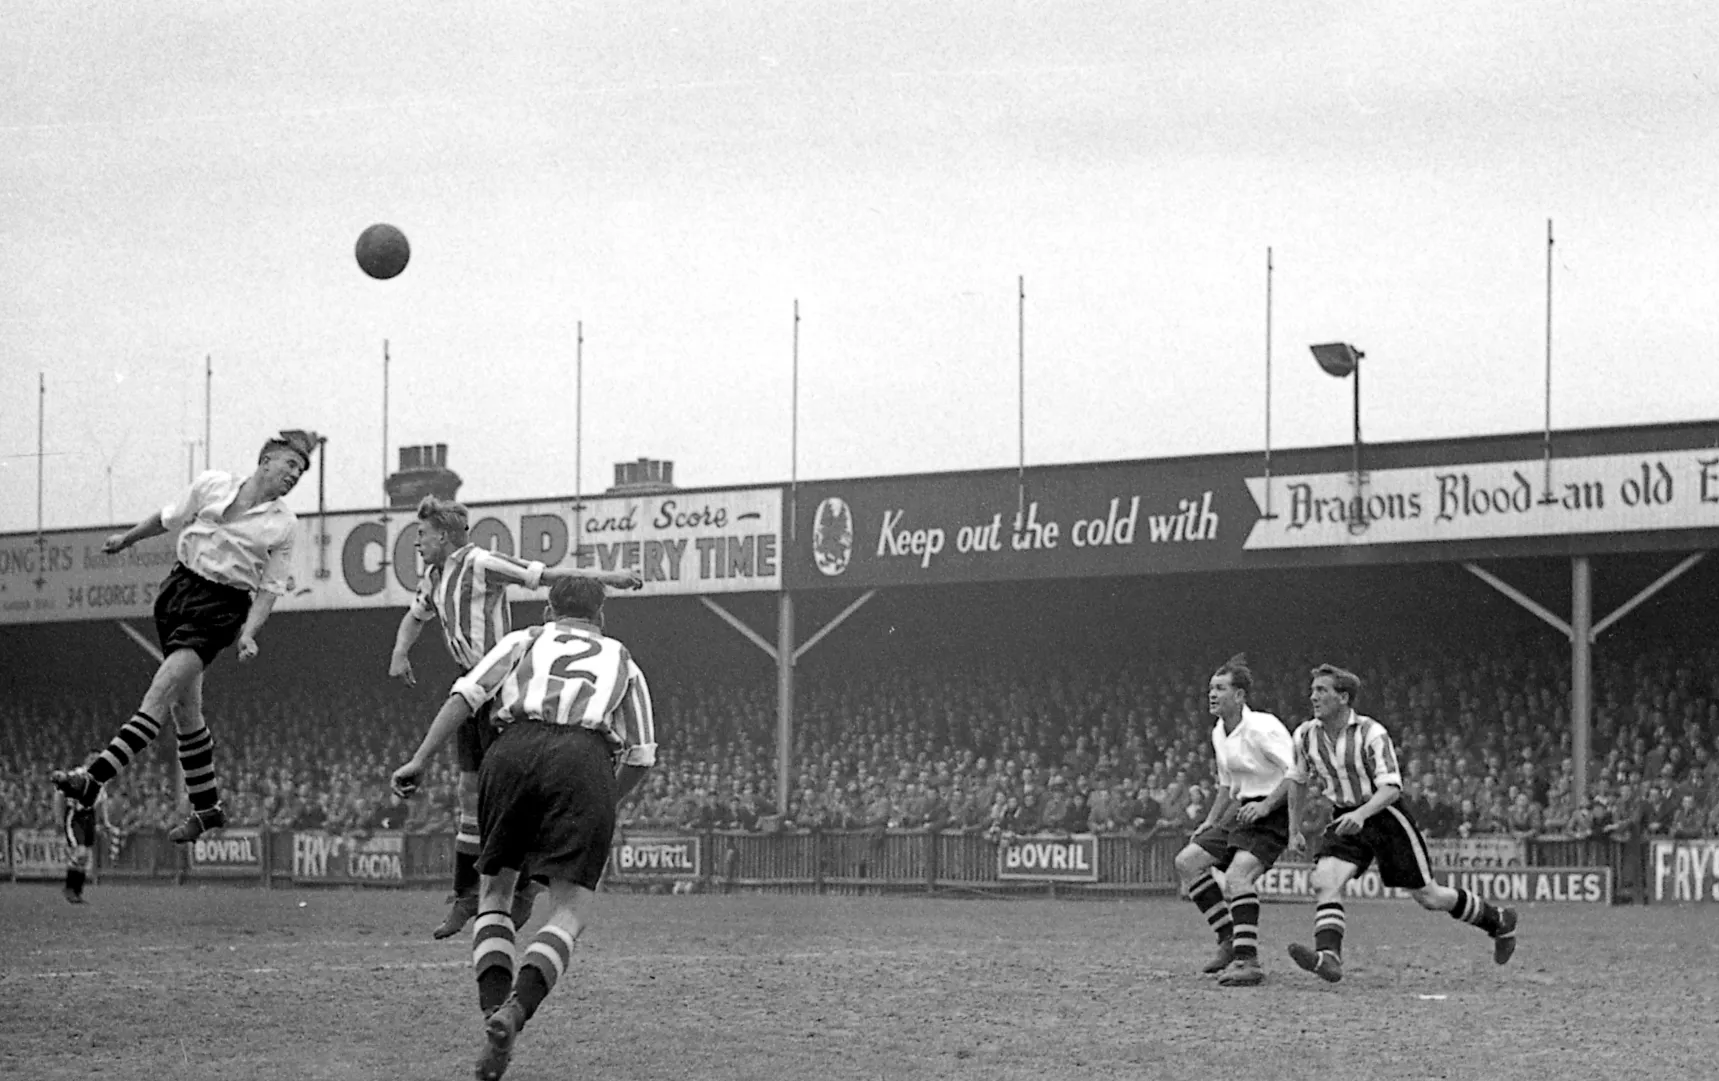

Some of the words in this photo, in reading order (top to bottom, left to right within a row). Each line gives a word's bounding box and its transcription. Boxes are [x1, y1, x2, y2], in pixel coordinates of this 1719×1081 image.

[1285, 482, 1421, 536] Dragons
[1434, 470, 1532, 524] Blood
[1563, 481, 1604, 510] an
[1621, 461, 1673, 506] old
[585, 505, 638, 533] and
[652, 500, 728, 529] Score
[877, 509, 945, 568] Keep
[956, 513, 1002, 553] out
[1011, 502, 1058, 549] the
[1072, 496, 1140, 546] cold
[1149, 491, 1219, 541] with
[576, 537, 689, 582] EVERY
[696, 534, 777, 580] TIME
[548, 633, 603, 685] 2
[194, 838, 257, 861] BOVRIL
[621, 845, 693, 869] BOVRIL
[1006, 843, 1089, 870] BOVRIL
[1534, 873, 1600, 901] ALES
